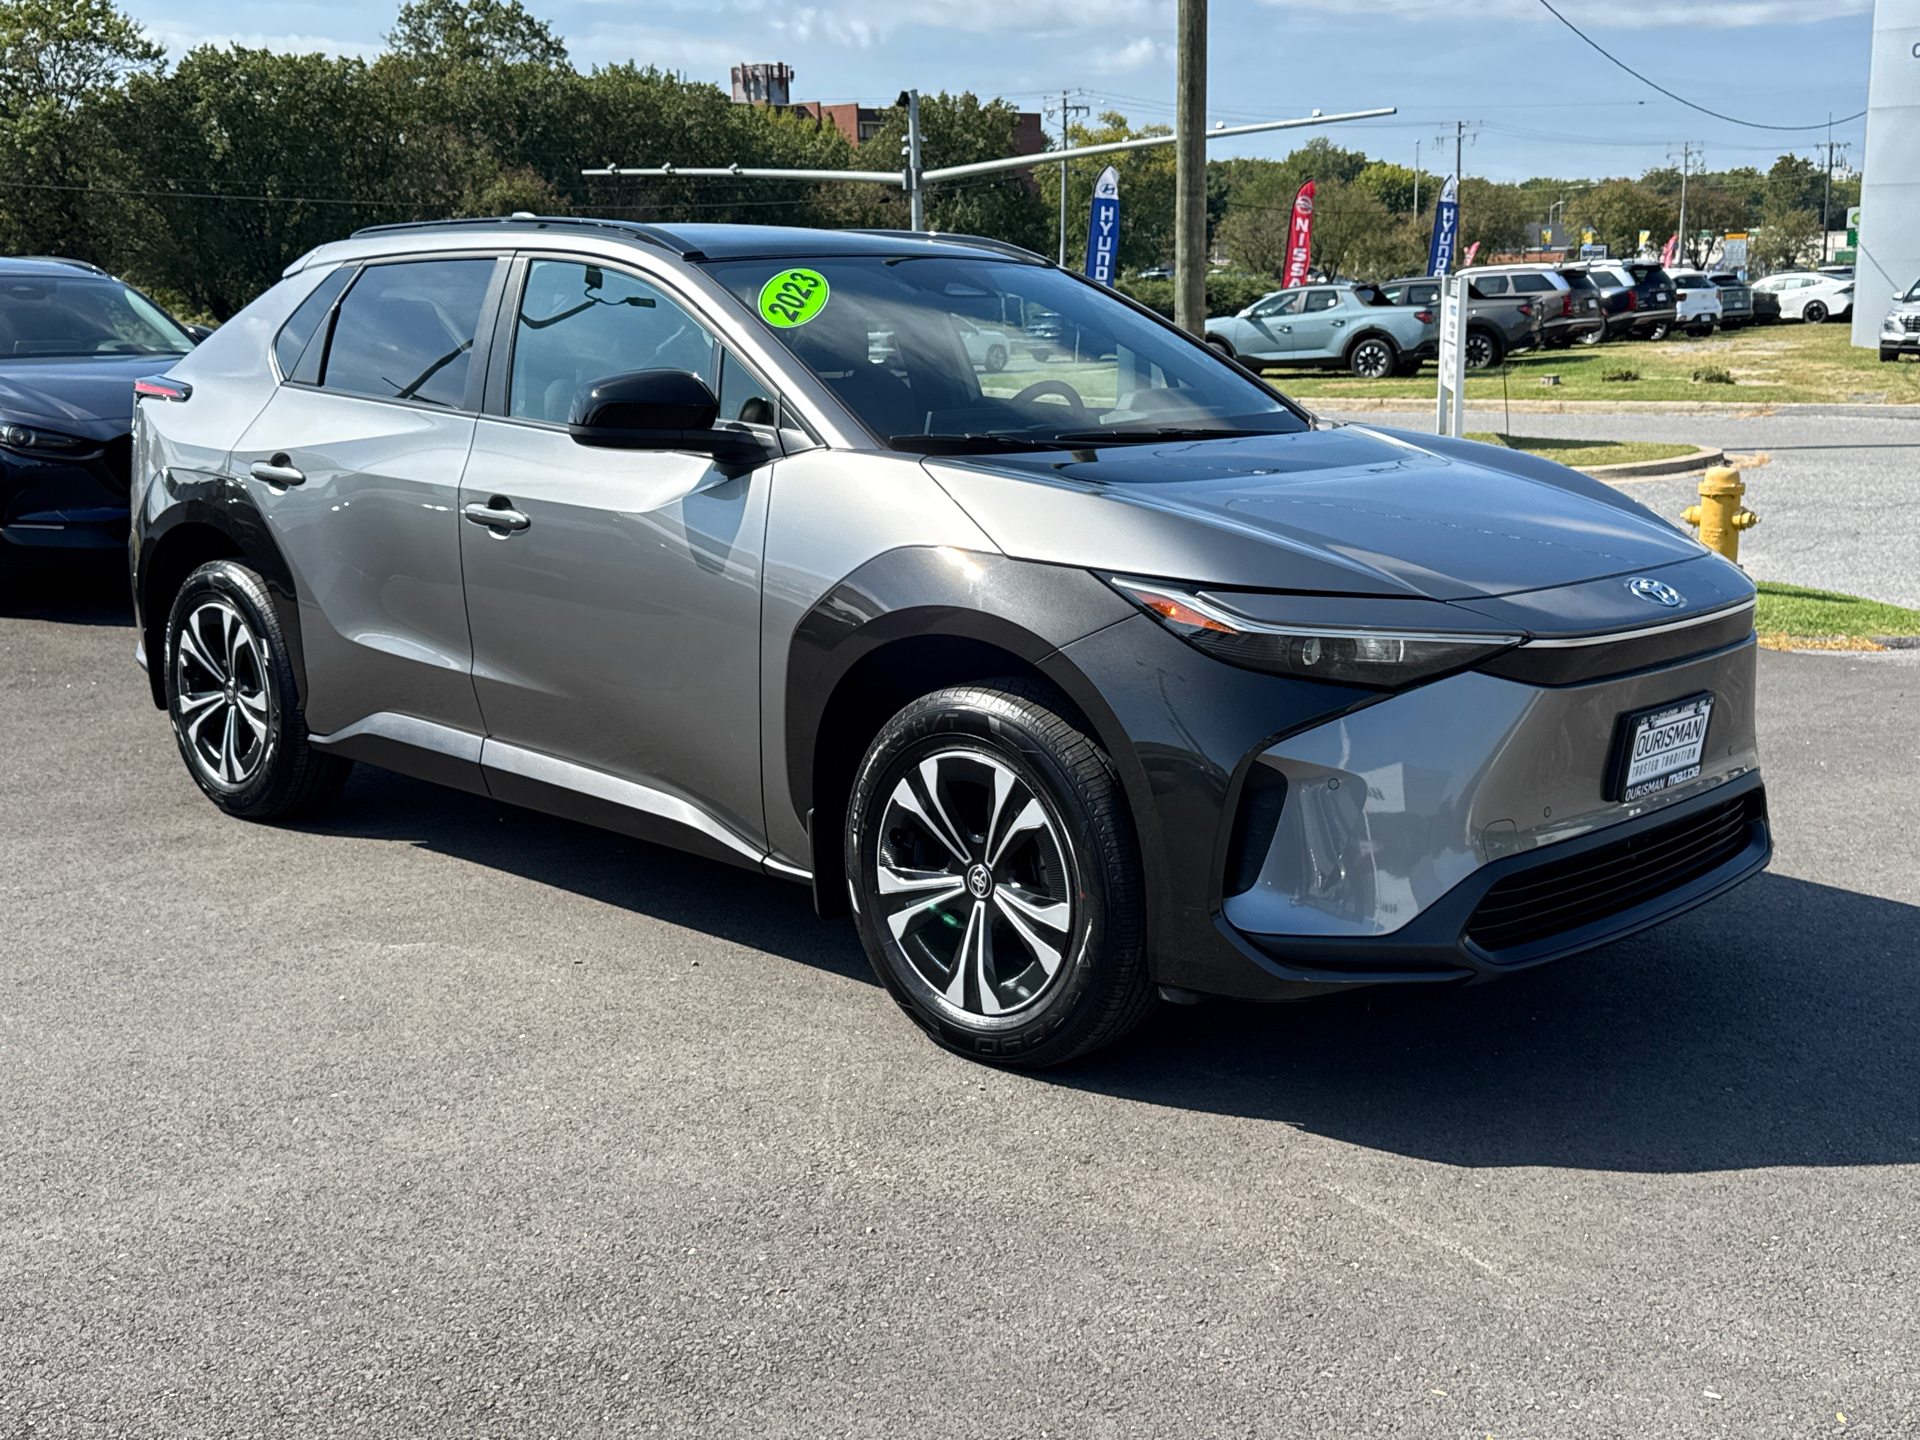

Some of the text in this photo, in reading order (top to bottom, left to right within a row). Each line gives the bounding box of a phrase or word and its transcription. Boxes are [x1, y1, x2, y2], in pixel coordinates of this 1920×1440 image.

[768, 272, 821, 323] 2023
[1636, 719, 1702, 756] OURISMAN
[1632, 747, 1697, 778] TRUSTED TRADITION
[1625, 778, 1666, 801] OURISMAN
